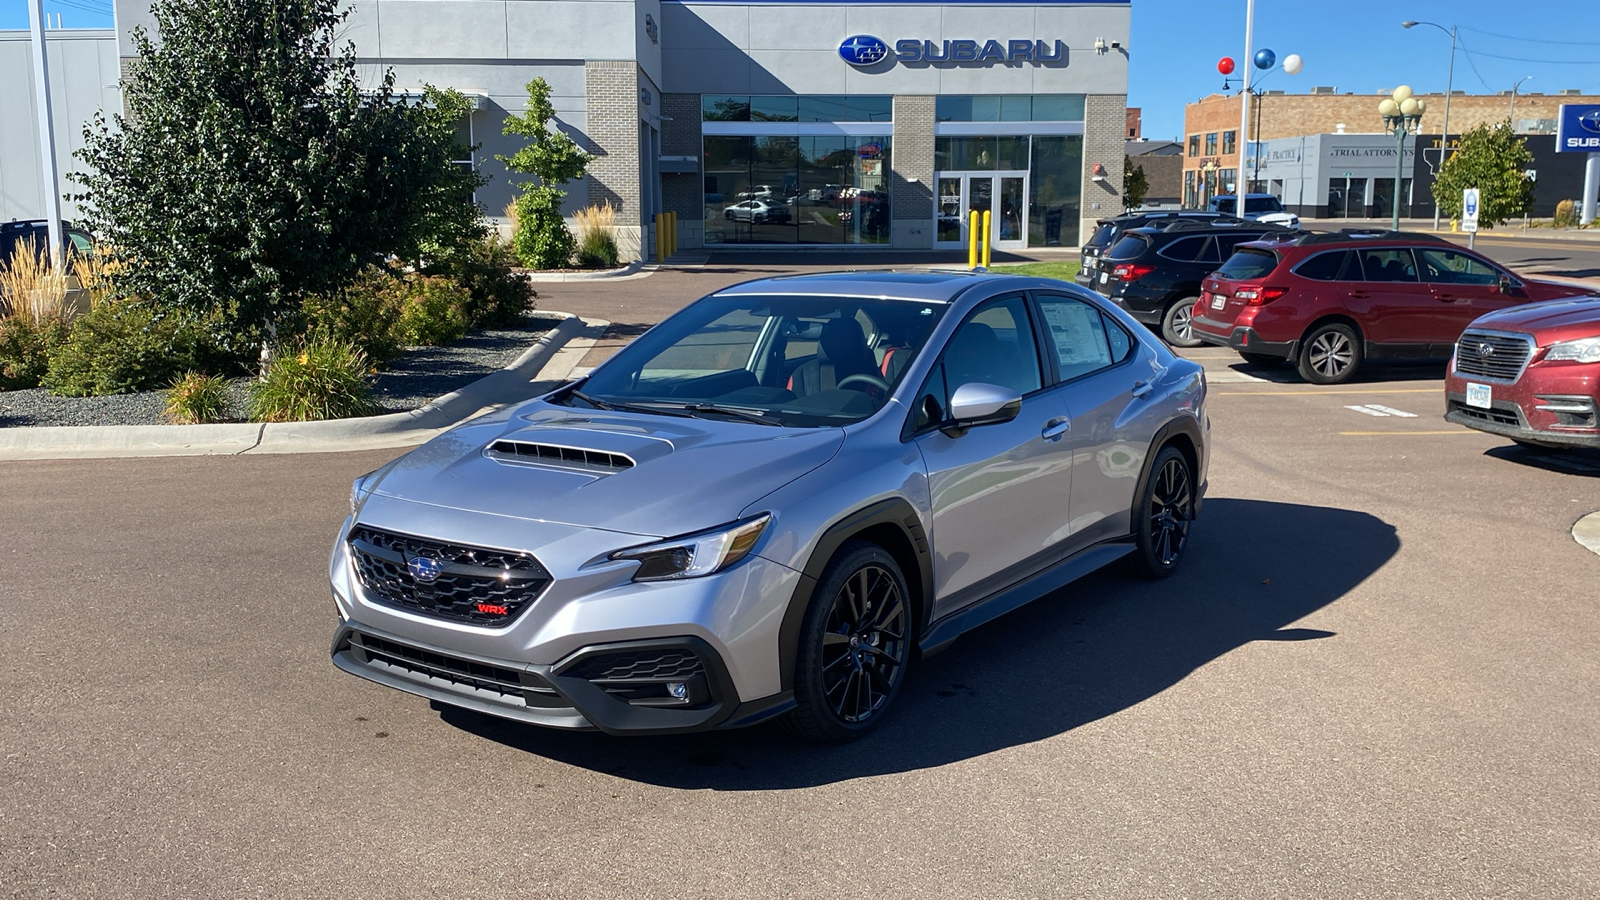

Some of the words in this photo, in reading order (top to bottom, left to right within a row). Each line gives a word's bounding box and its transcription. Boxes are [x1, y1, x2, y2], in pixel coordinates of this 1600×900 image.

[896, 39, 1062, 61] SUBARU
[1567, 137, 1600, 147] SUB
[1273, 150, 1296, 160] PRACTICE
[1334, 149, 1361, 157] TRIAL
[1363, 149, 1414, 157] ATTORNYS
[478, 604, 507, 615] WRX
